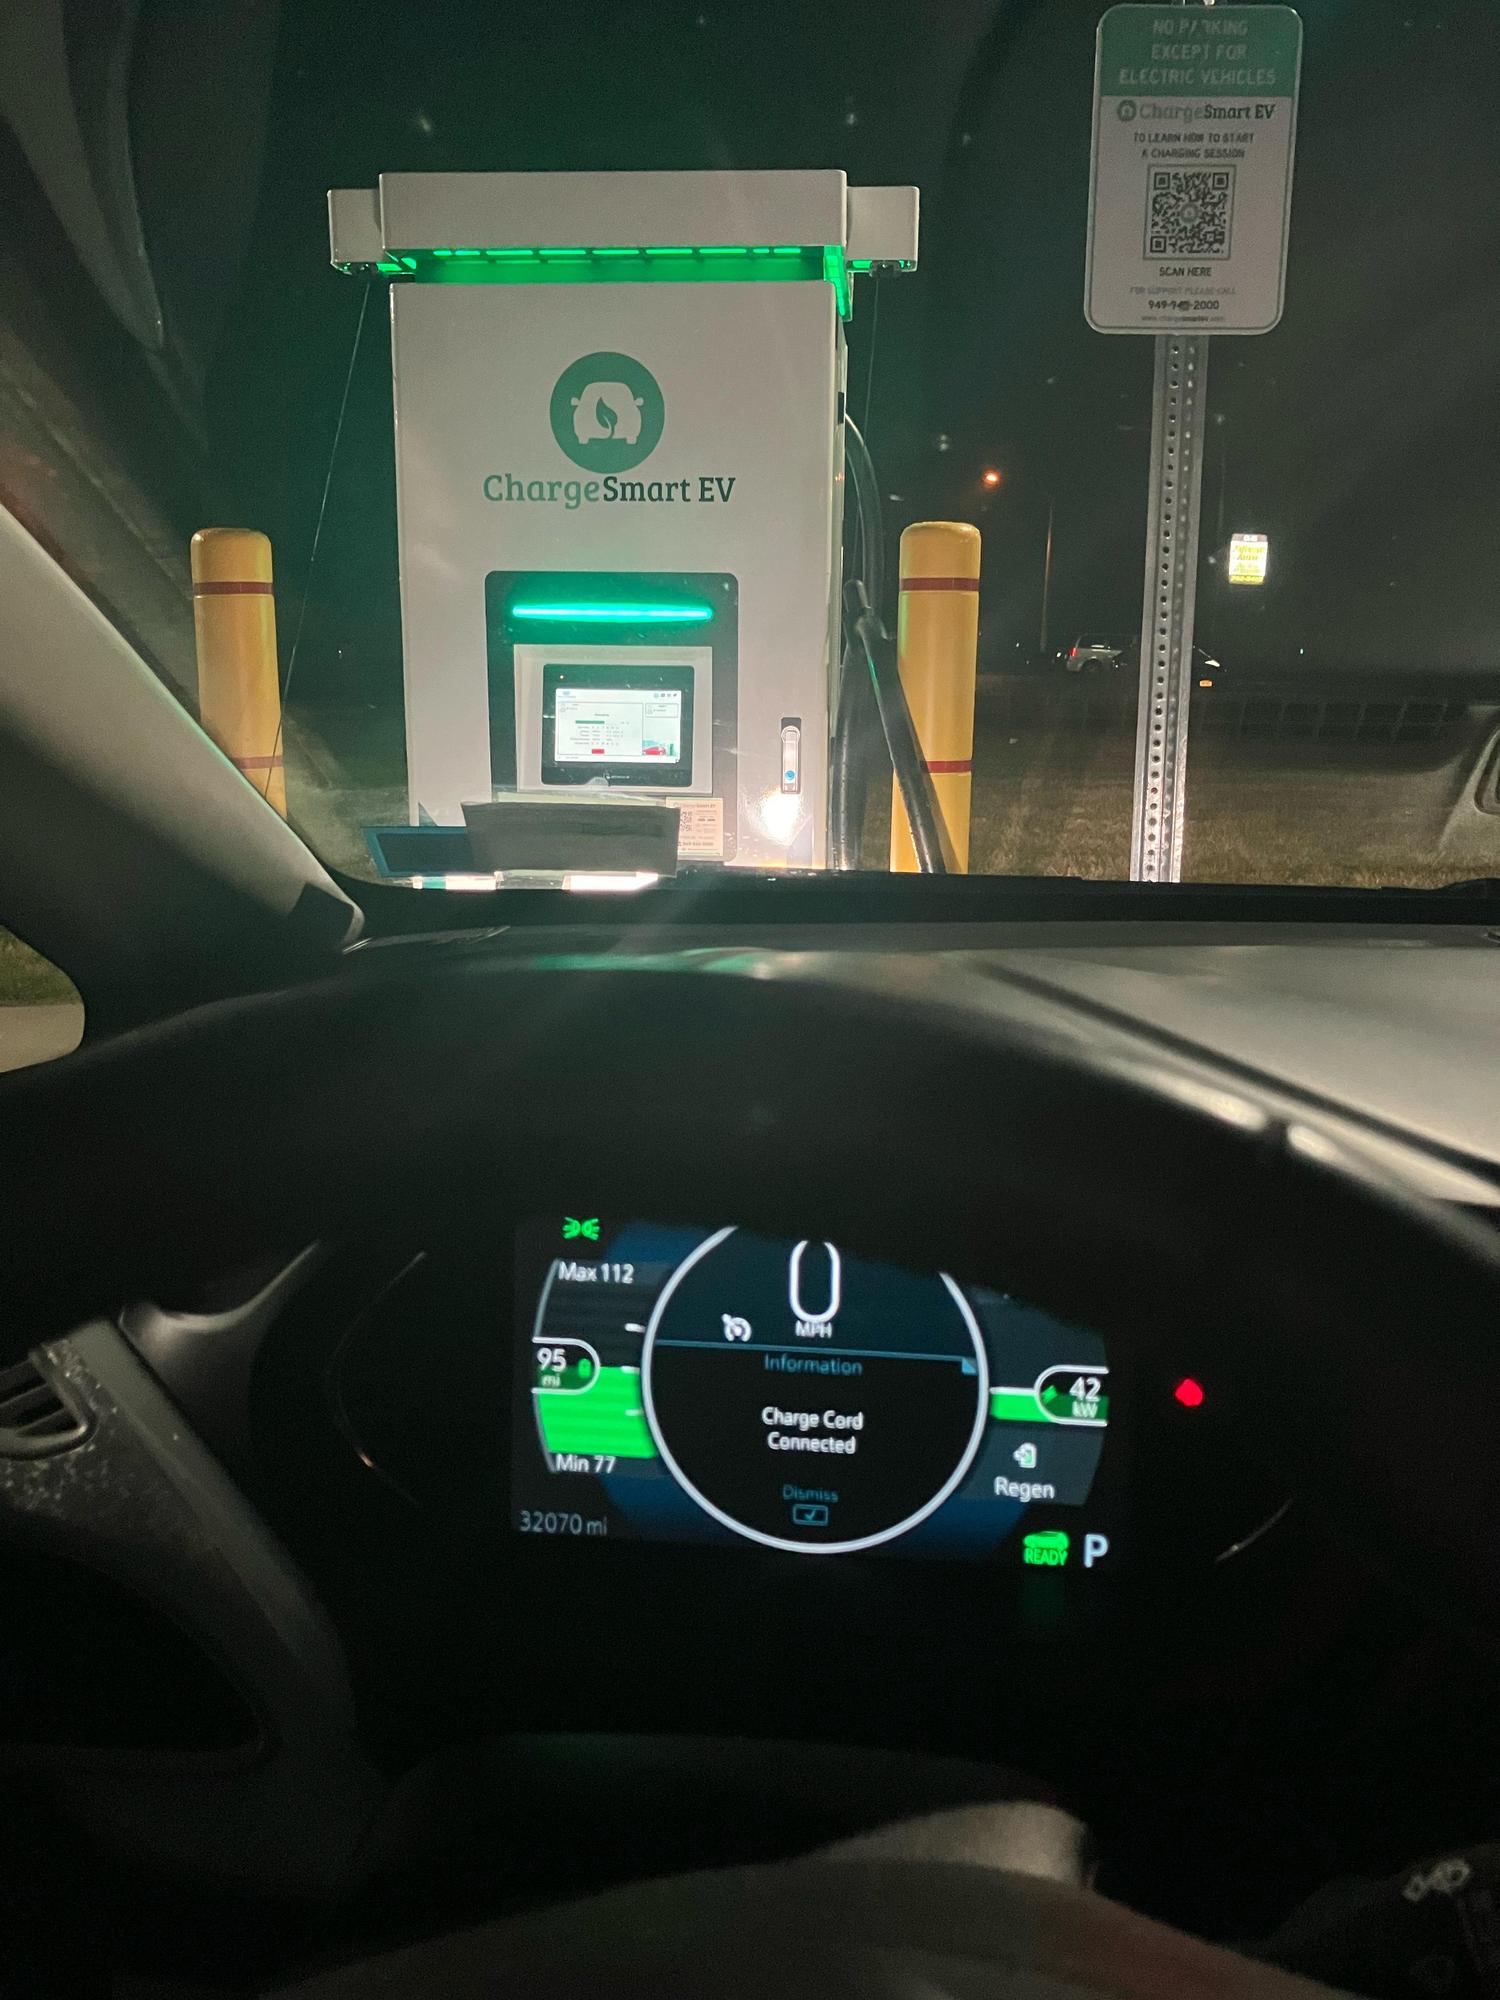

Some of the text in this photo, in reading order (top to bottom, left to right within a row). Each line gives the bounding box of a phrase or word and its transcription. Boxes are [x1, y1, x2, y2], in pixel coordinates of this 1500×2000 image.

[1153, 20, 1174, 35] NO
[1151, 44, 1248, 60] EXCEPT FOR
[1119, 67, 1276, 85] ELECTRIC VEHICLES
[1139, 103, 1276, 123] ChargeSmart EV
[1134, 133, 1146, 143] TO
[1148, 133, 1181, 143] LEARN
[1208, 133, 1221, 143] TO
[1222, 133, 1254, 143] START
[1151, 149, 1201, 158] CHARGING
[1204, 149, 1246, 158] SESSION
[1159, 267, 1212, 276] SCAN HERE
[483, 473, 736, 510] ChargeSmart EV
[558, 1261, 634, 1284] Max 112
[789, 1240, 841, 1323] 0
[795, 1319, 833, 1338] MPH
[536, 1347, 567, 1371] 95
[764, 1353, 863, 1376] Information
[541, 1375, 561, 1388] mi
[1069, 1376, 1101, 1402] 42
[762, 1406, 864, 1431] Charge Cord
[767, 1432, 856, 1454] Connected
[555, 1454, 616, 1474] Min 77
[782, 1484, 839, 1503] Dismiss
[994, 1476, 1055, 1502] Regen
[519, 1511, 607, 1535] 32070 mi
[1023, 1547, 1069, 1566] READY
[1083, 1533, 1109, 1568] P
